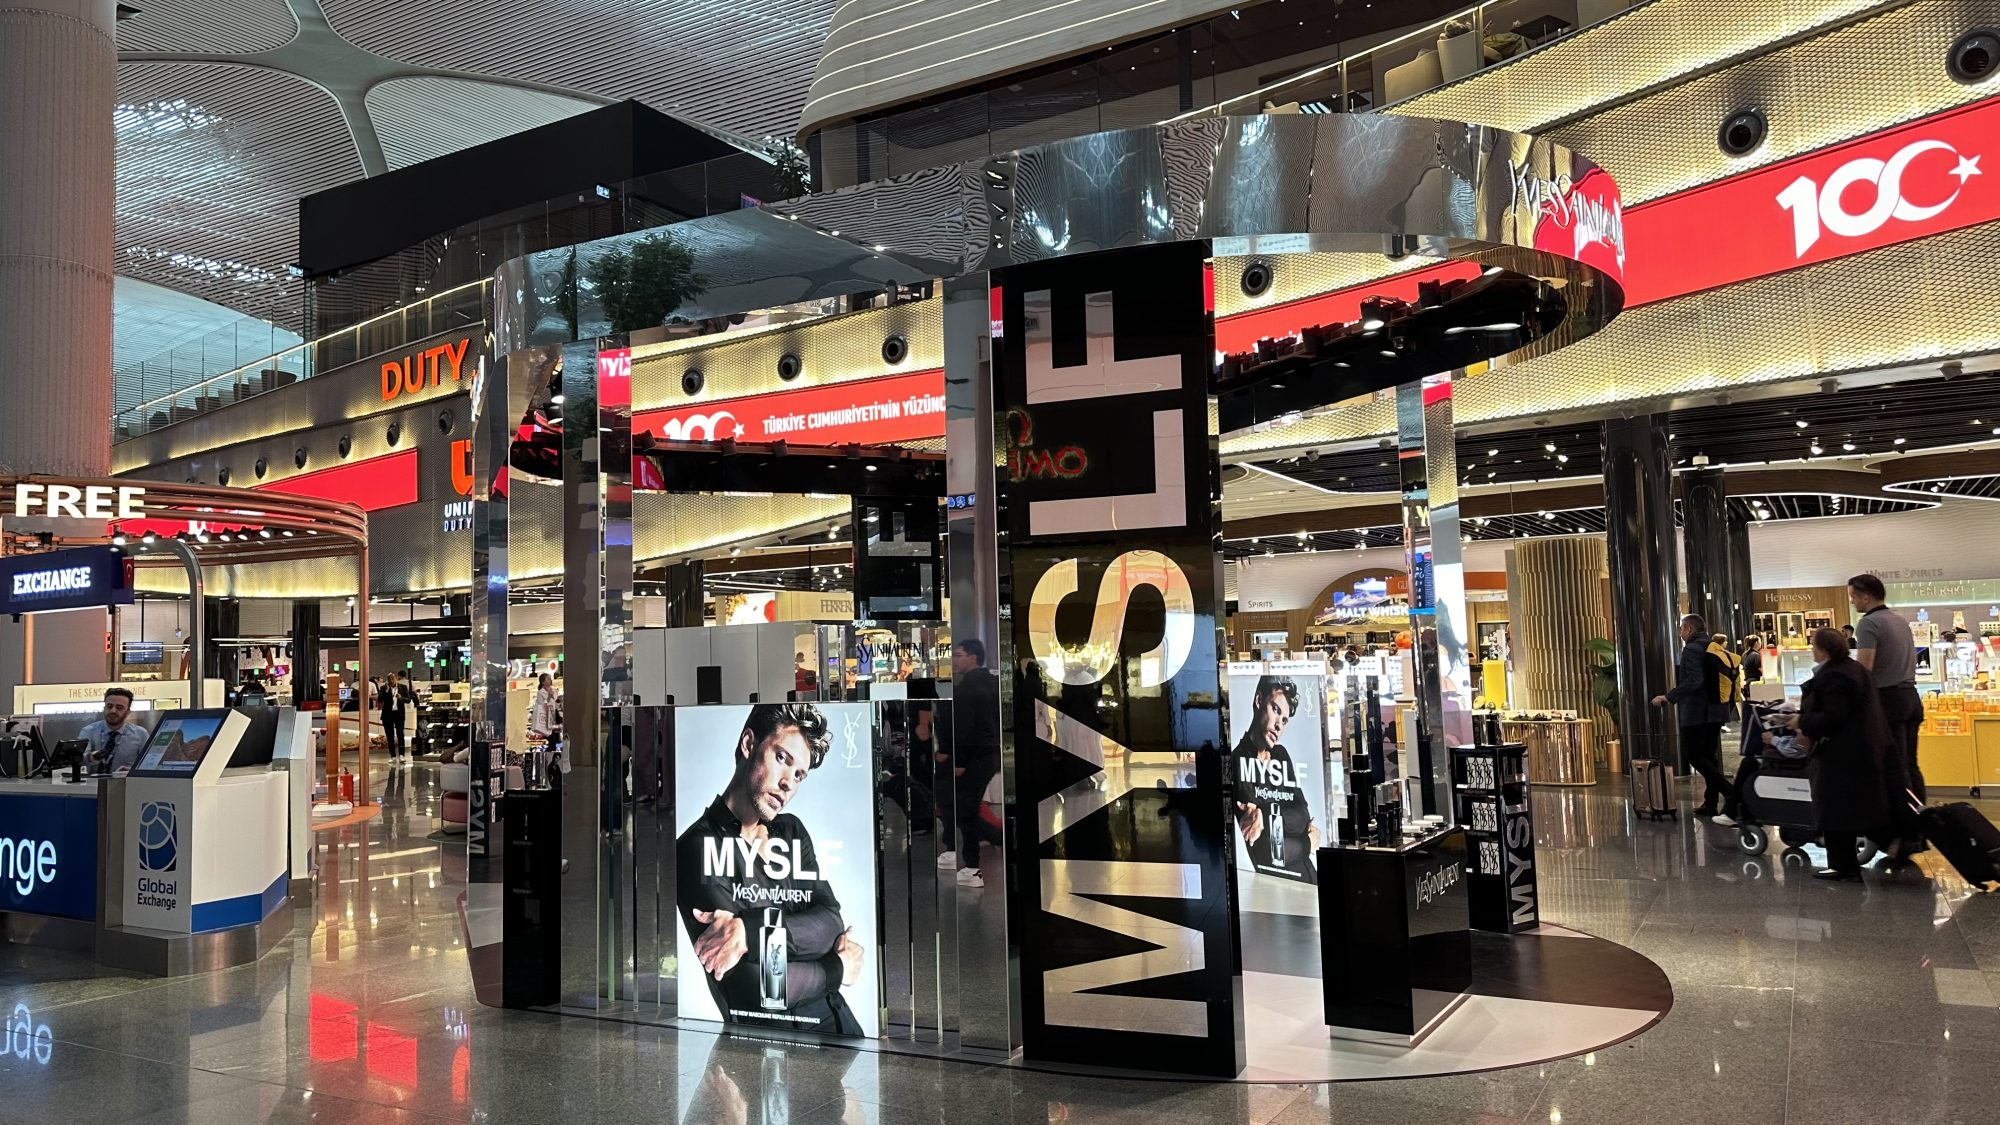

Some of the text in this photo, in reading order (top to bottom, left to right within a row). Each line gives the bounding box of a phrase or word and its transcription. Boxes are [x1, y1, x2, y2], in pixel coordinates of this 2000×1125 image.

[381, 338, 470, 401] DUTY
[763, 413, 806, 434] TÜRKİYE
[807, 399, 900, 429] CUMHURİYETİ'NİN
[15, 484, 146, 519] FREE
[444, 517, 472, 532] DUTY
[13, 566, 91, 595] EXCHANGE
[1903, 568, 1944, 579] SPIRITS
[1247, 600, 1273, 609] SPIRITS
[1765, 592, 1813, 603] Hennessy
[1336, 607, 1367, 618] MALT
[1024, 288, 1209, 1038] MYSLF
[69, 688, 81, 698] THE
[1239, 756, 1308, 789] MYSLF
[1503, 756, 1536, 926] MYSLF
[704, 836, 844, 881] MYSLF
[138, 877, 177, 895] Global
[137, 892, 177, 911] Exchange
